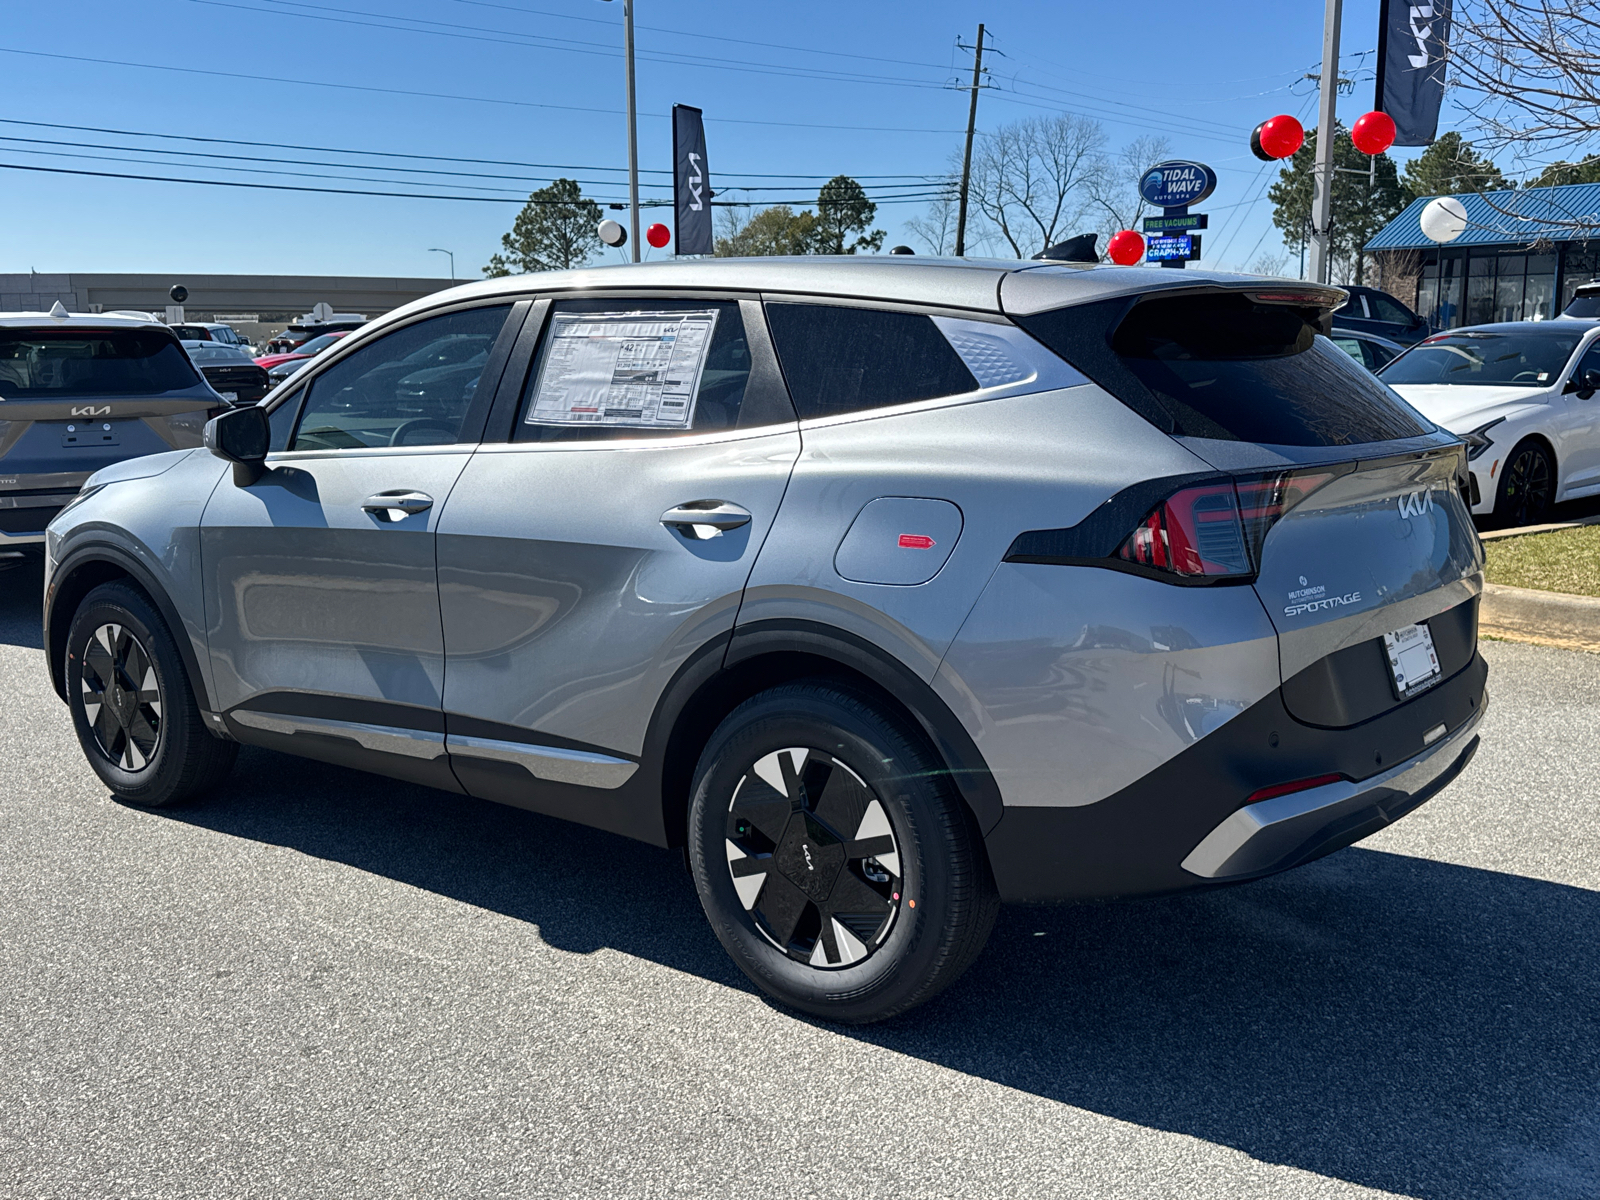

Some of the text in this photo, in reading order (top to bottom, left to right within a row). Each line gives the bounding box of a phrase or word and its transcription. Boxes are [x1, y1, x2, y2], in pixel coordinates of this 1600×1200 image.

[1407, 0, 1434, 68] KI
[688, 152, 703, 211] KIA
[1163, 168, 1195, 181] TIDAL
[1167, 180, 1201, 193] WAVE
[1145, 217, 1197, 229] FREE VACUUMS
[624, 343, 635, 352] 42
[71, 405, 111, 416] KIA
[1397, 489, 1434, 520] KIA
[1288, 585, 1326, 600] HUTCHINSON
[1284, 591, 1362, 617] SPORTAGE
[801, 844, 814, 871] KIA
